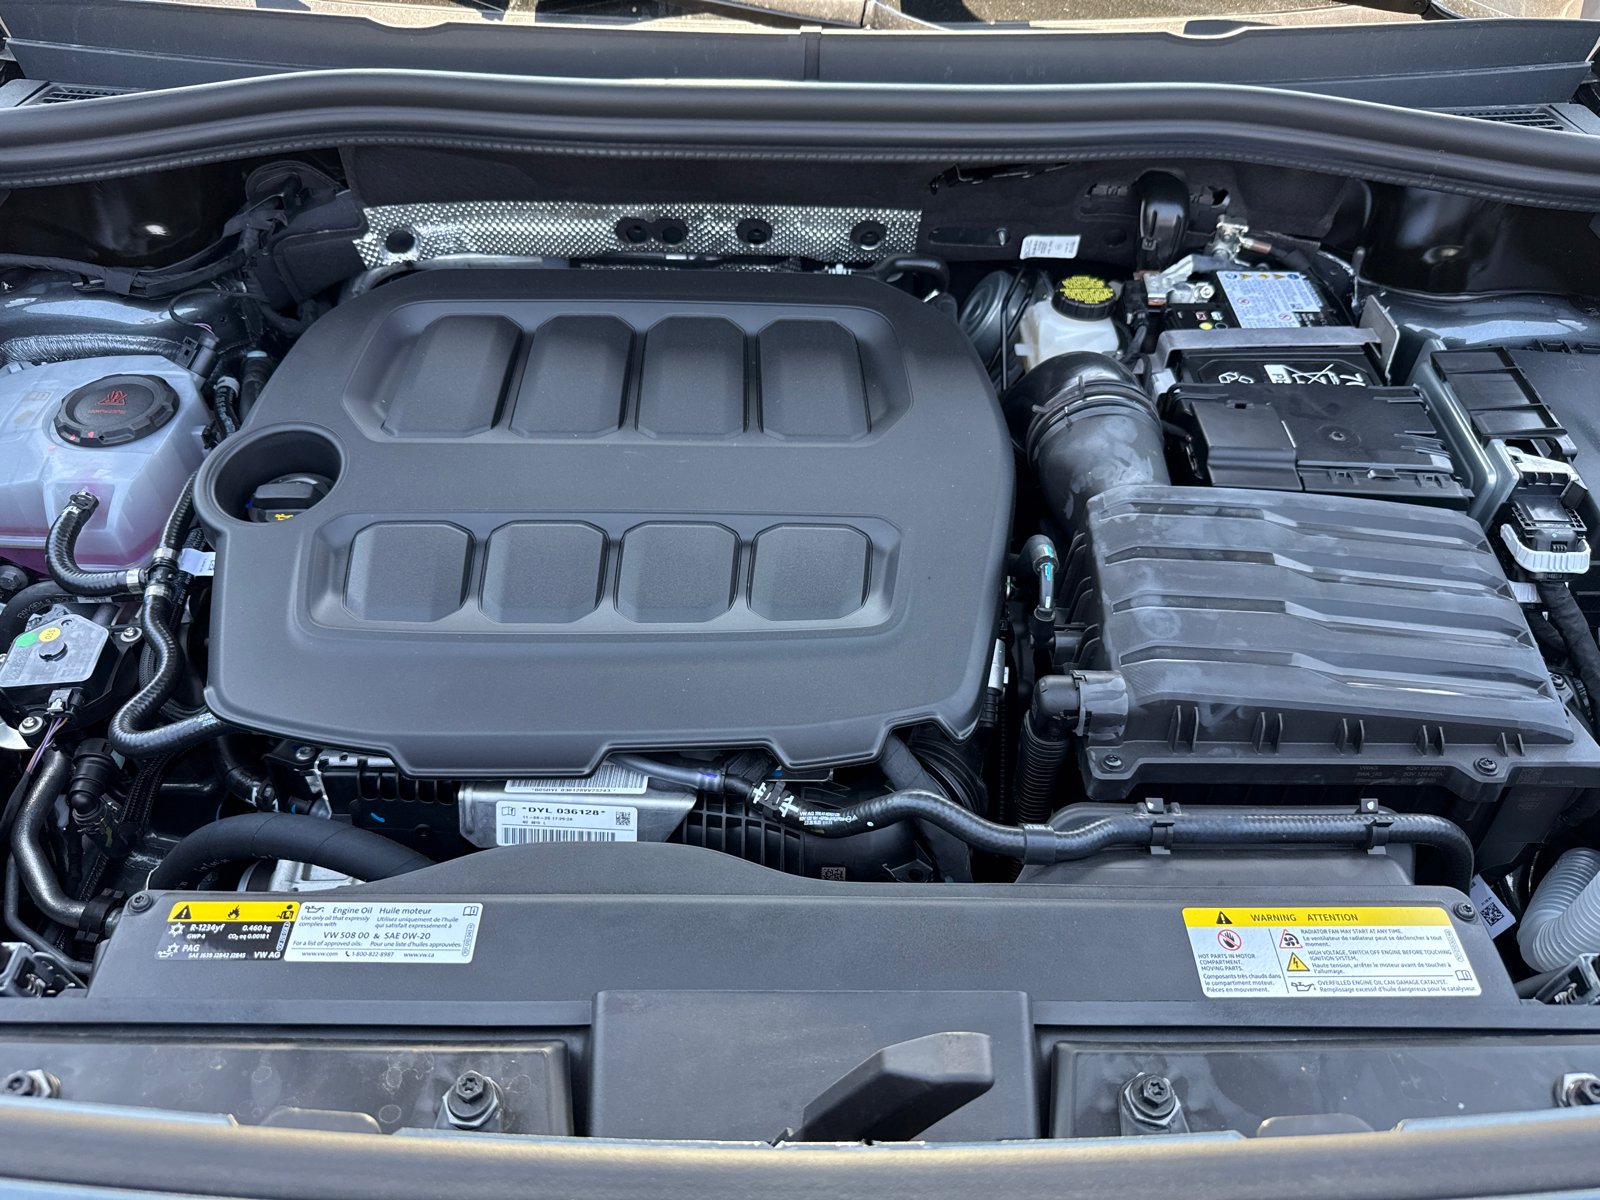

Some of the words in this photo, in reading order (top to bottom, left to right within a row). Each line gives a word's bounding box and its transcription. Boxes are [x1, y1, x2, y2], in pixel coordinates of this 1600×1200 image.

[333, 907, 359, 915] Engine
[379, 907, 400, 915] Huile
[189, 924, 225, 933] R-1234yf
[263, 925, 272, 933] kg
[384, 932, 400, 940] SAE
